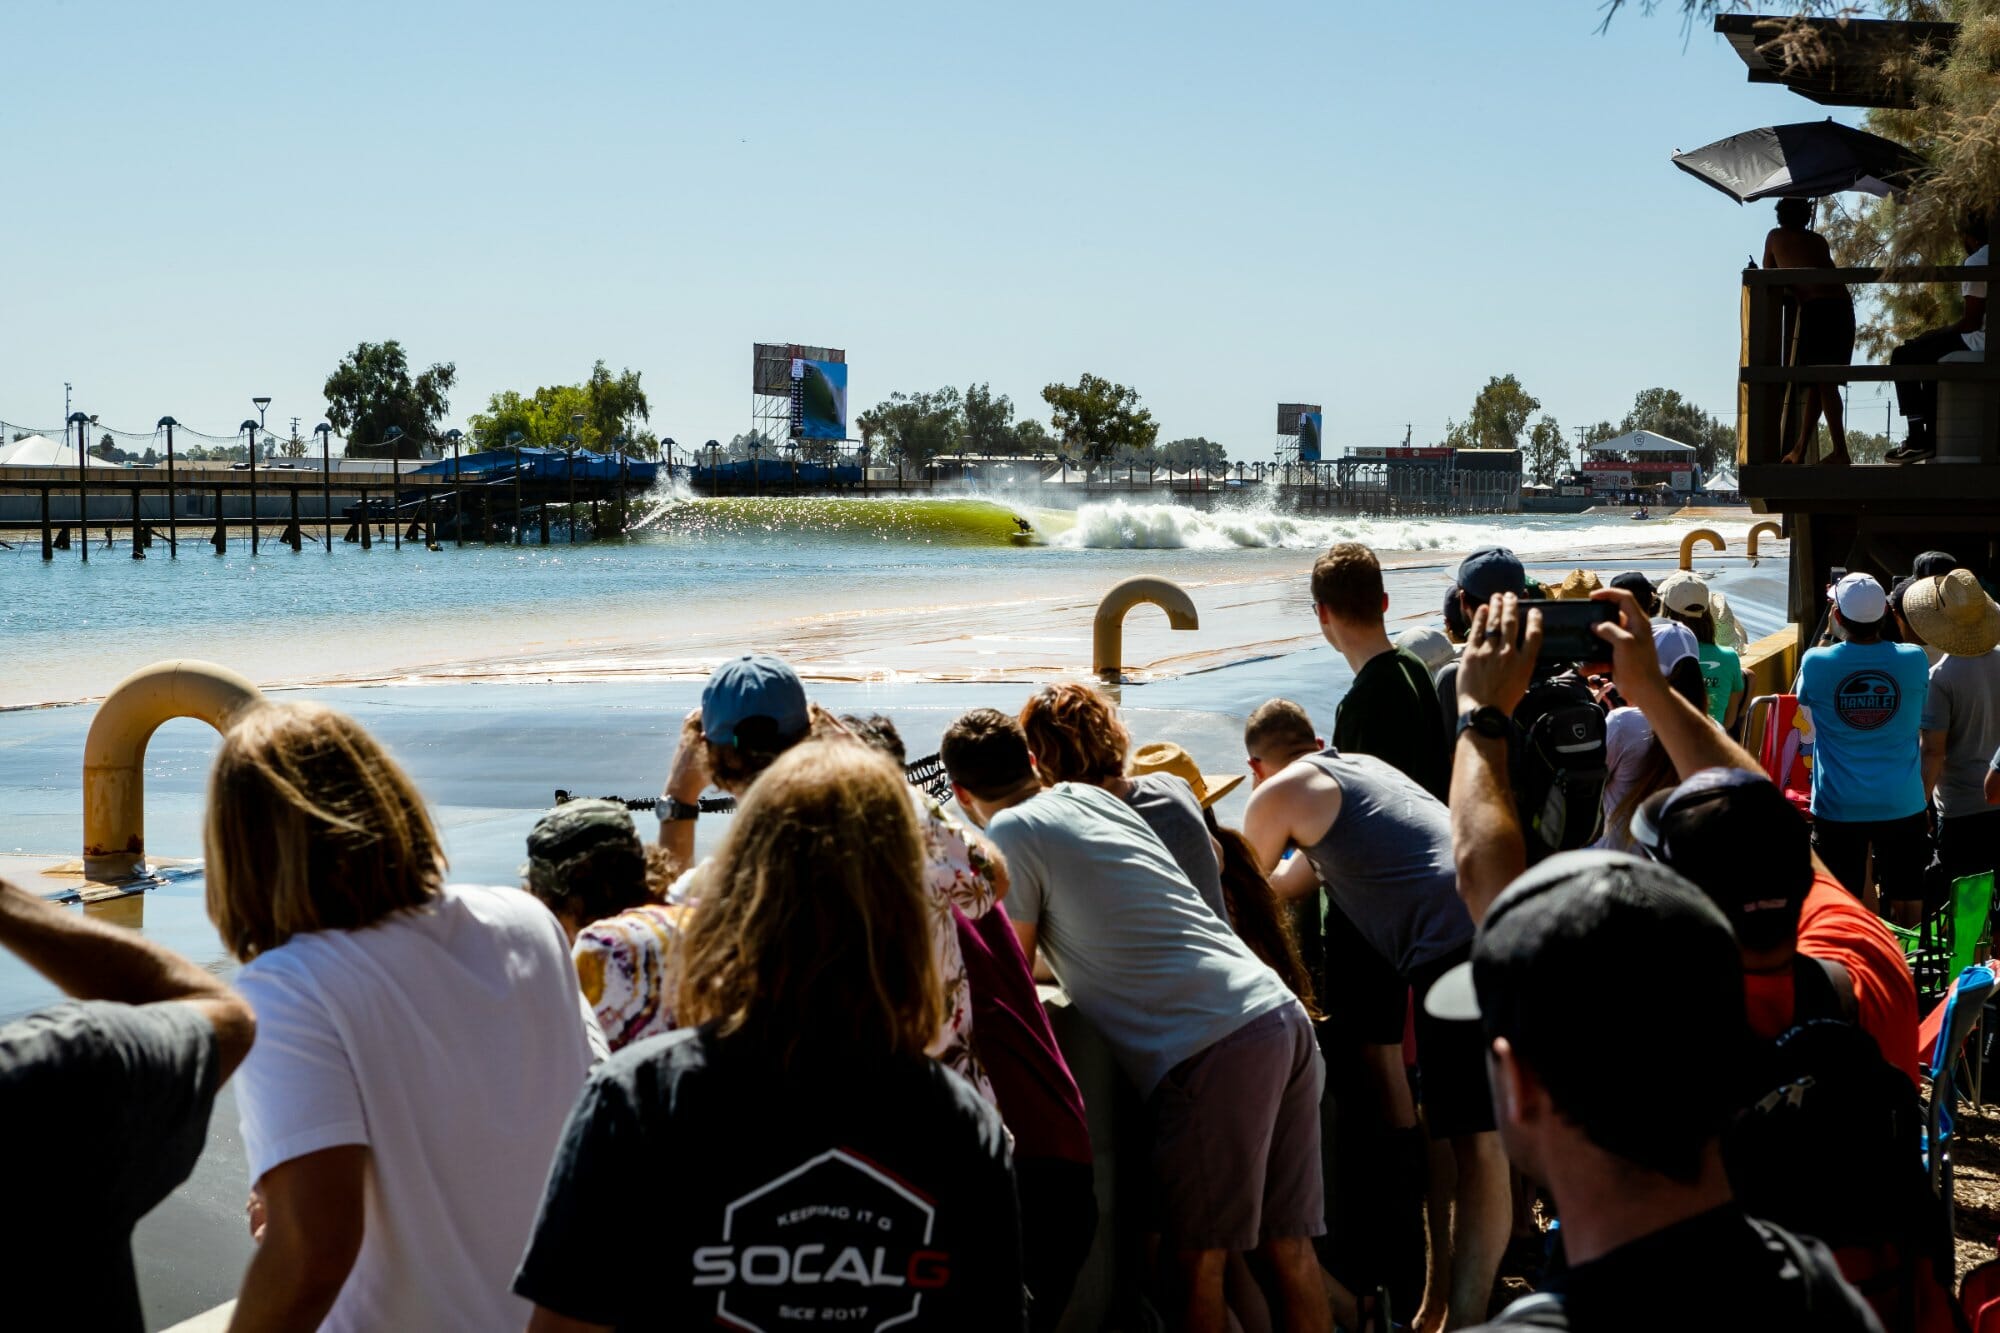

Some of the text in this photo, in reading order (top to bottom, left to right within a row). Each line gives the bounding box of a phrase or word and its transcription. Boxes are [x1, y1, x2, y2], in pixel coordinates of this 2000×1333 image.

[1840, 696, 1895, 709] HANALEI
[776, 1203, 851, 1228] KEEPING
[855, 1208, 874, 1224] IT
[821, 1304, 869, 1320] 2017
